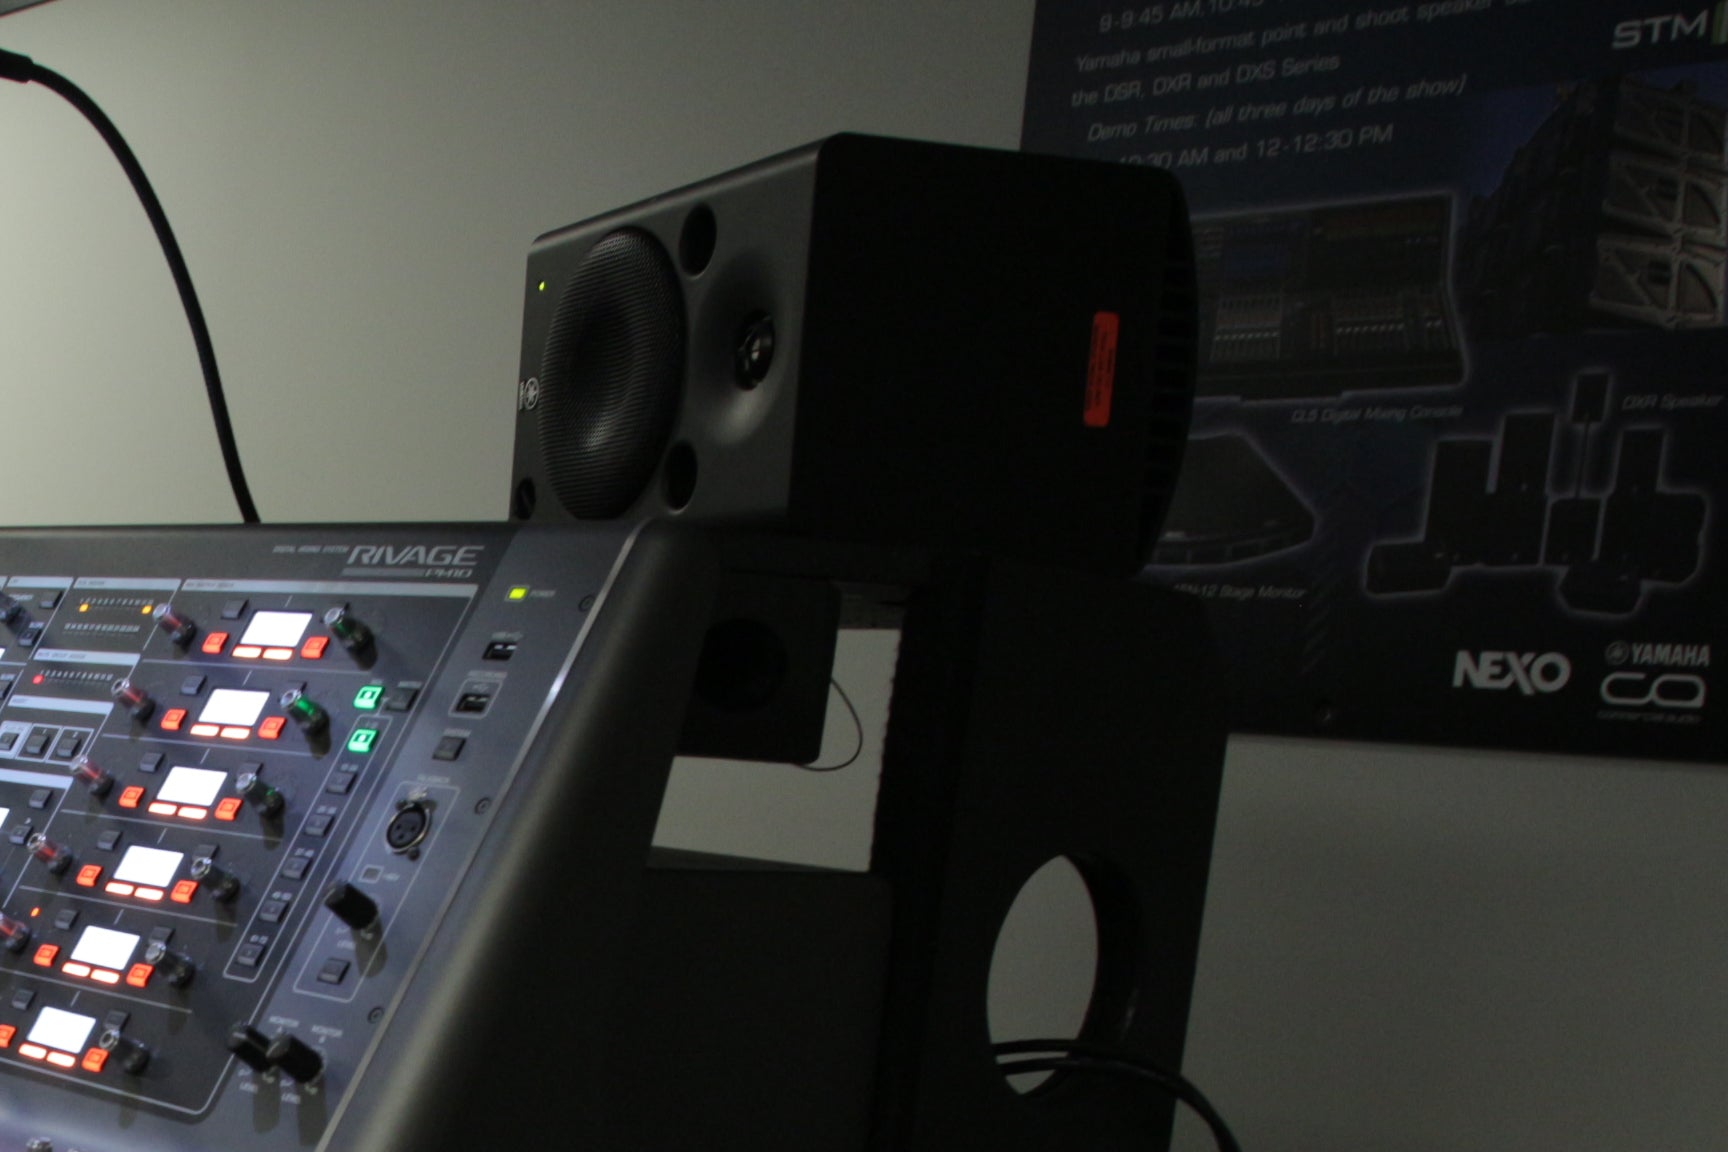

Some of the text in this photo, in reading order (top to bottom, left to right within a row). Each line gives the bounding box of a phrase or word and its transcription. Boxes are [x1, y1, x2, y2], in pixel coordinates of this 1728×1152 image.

[1076, 49, 1141, 72] Yamaha
[1261, 22, 1307, 48] point
[1314, 14, 1349, 36] and
[1355, 6, 1409, 30] shoot
[1611, 8, 1710, 50] STM
[1072, 88, 1099, 107] the
[1197, 66, 1231, 90] and
[1281, 54, 1342, 77] Series
[1087, 121, 1138, 143] Demo
[1238, 101, 1288, 122] three
[1292, 94, 1337, 117] days
[1342, 86, 1364, 109] of
[1367, 85, 1400, 105] the
[1405, 72, 1468, 100] show)
[1177, 146, 1210, 168] AM
[1213, 142, 1248, 164] and
[1358, 123, 1394, 146] PM
[347, 545, 485, 566] RIVAGE
[1452, 649, 1572, 696] NEXO
[1631, 642, 1712, 668] YAMAHA
